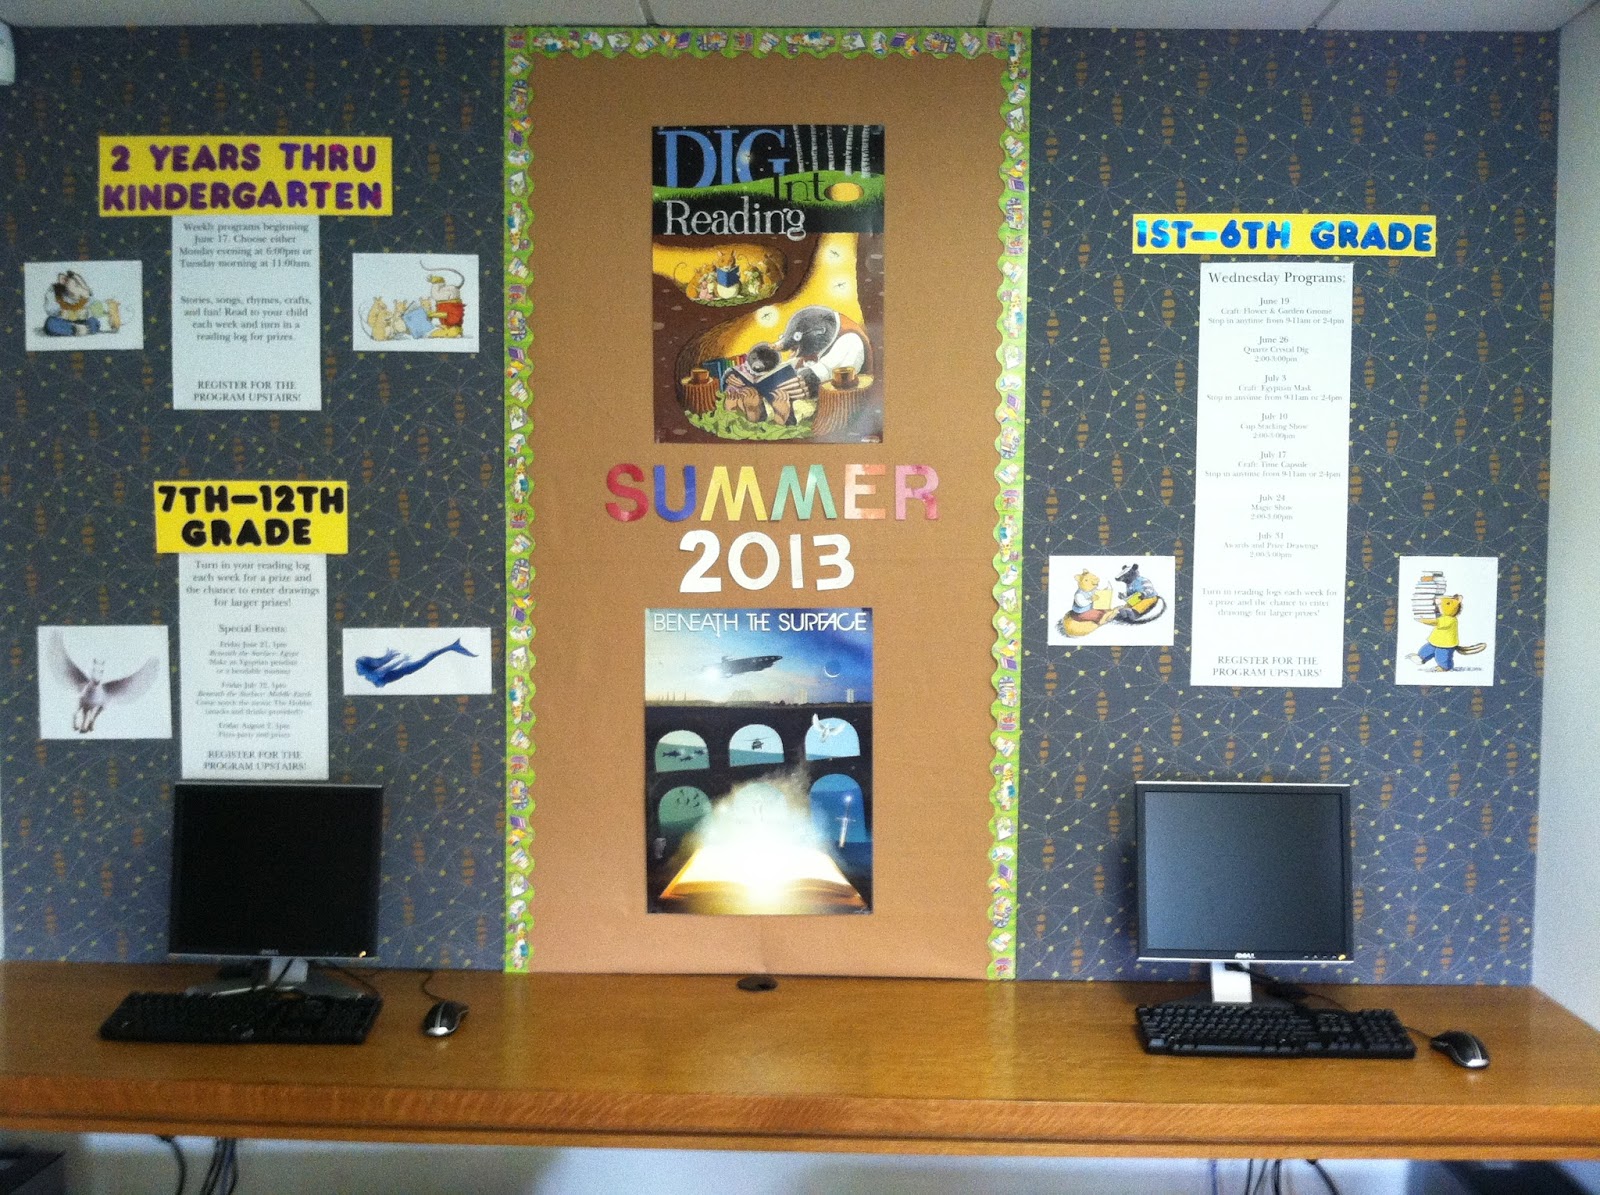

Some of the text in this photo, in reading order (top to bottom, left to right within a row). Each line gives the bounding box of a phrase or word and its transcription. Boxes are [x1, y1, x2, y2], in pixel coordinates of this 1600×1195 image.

[111, 142, 376, 172] 2 YEARS THRU
[657, 129, 791, 189] DIG
[102, 181, 383, 211] KINDERGARTEN
[662, 196, 807, 241] Reading
[1310, 220, 1432, 252] GRADE
[1208, 272, 1346, 286] Wednesday Programs:
[1259, 298, 1278, 306] June
[1208, 318, 1225, 326] Stop
[1258, 336, 1277, 346] June
[1296, 346, 1309, 355] Dig
[1264, 374, 1279, 384] July
[198, 380, 296, 390] REGISTER FOR THE
[193, 392, 246, 402] PROGRAM
[1260, 412, 1276, 422] July
[1260, 451, 1276, 460] July
[605, 463, 940, 522] SUMMER
[1258, 494, 1273, 503] July
[181, 518, 312, 548] GRADE
[679, 529, 856, 593] 2013
[653, 612, 868, 637] BENEATH THE SURFACE
[1218, 656, 1318, 665] REGISTER FOR THE
[1212, 668, 1266, 676] PROGRAM
[208, 750, 302, 759] REGISTER FOR THE
